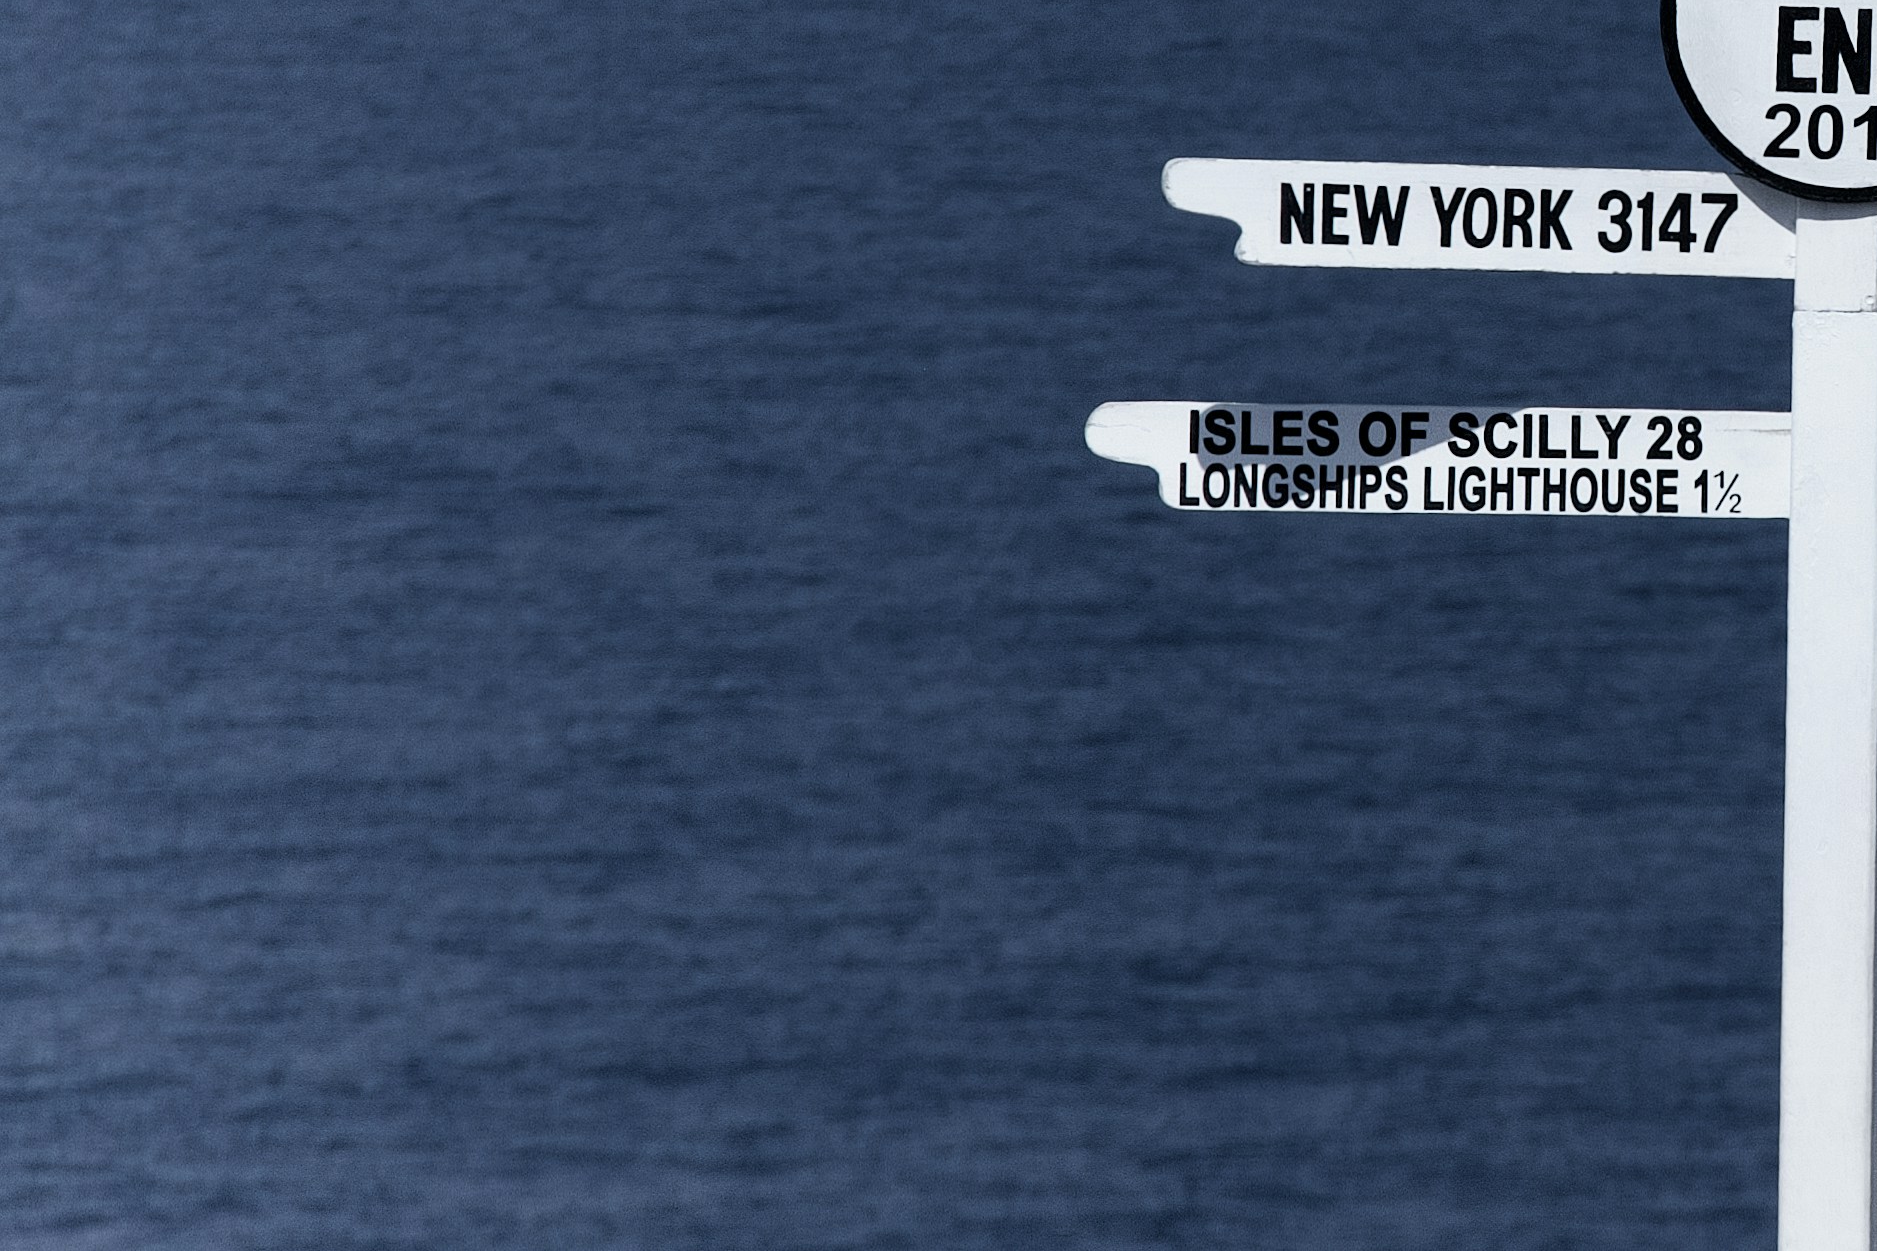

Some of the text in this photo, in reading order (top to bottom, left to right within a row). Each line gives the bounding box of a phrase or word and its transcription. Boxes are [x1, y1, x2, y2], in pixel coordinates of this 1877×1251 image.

[1280, 182, 1739, 254] NEW YORK 3147
[1189, 408, 1703, 461] ISLES OF SCILLY 28
[1178, 462, 1409, 511] LONGSHIPS
[1422, 466, 1679, 515] LIGHTHOUSE
